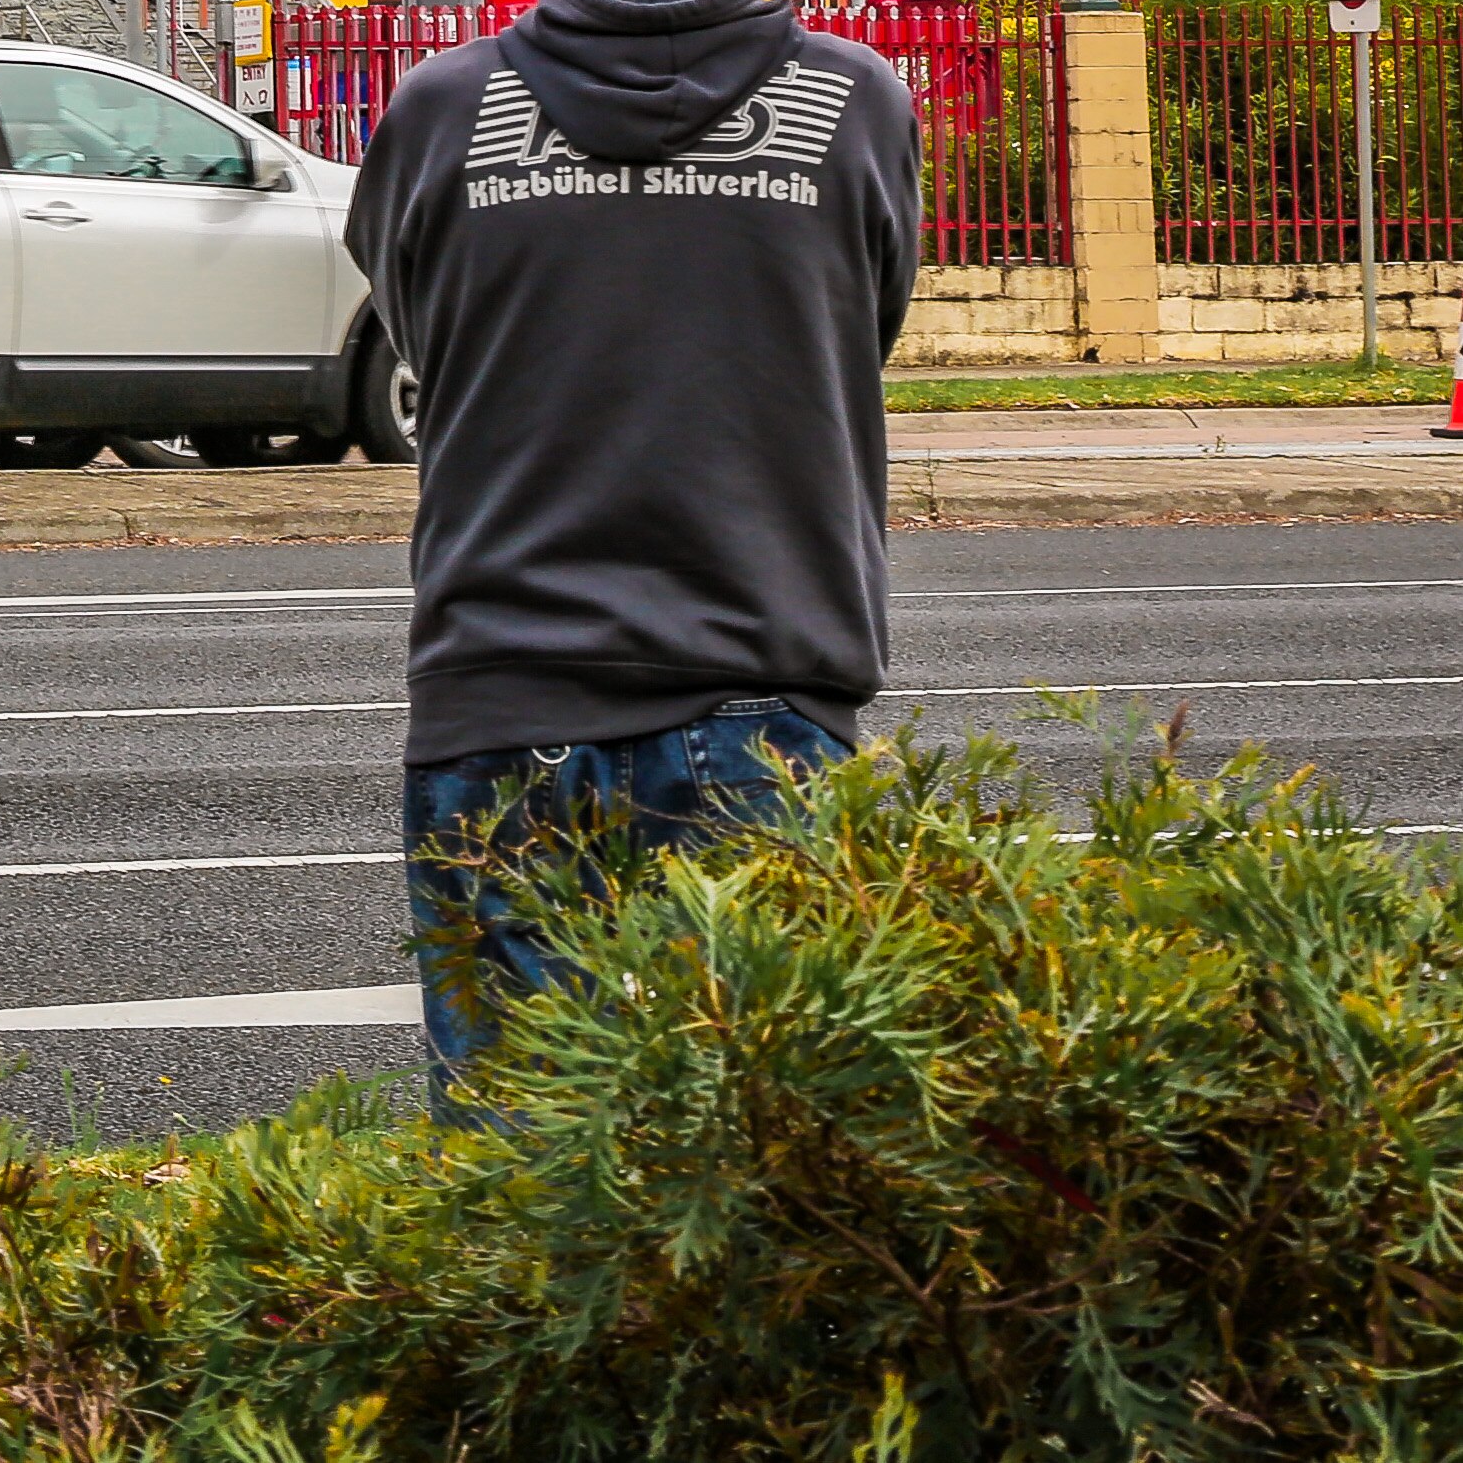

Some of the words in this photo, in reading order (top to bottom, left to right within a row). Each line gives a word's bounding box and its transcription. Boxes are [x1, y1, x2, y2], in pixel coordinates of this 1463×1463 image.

[242, 63, 266, 81] ENTRY
[466, 165, 631, 209] Kitzbühel
[643, 164, 819, 207] Skiverleih
